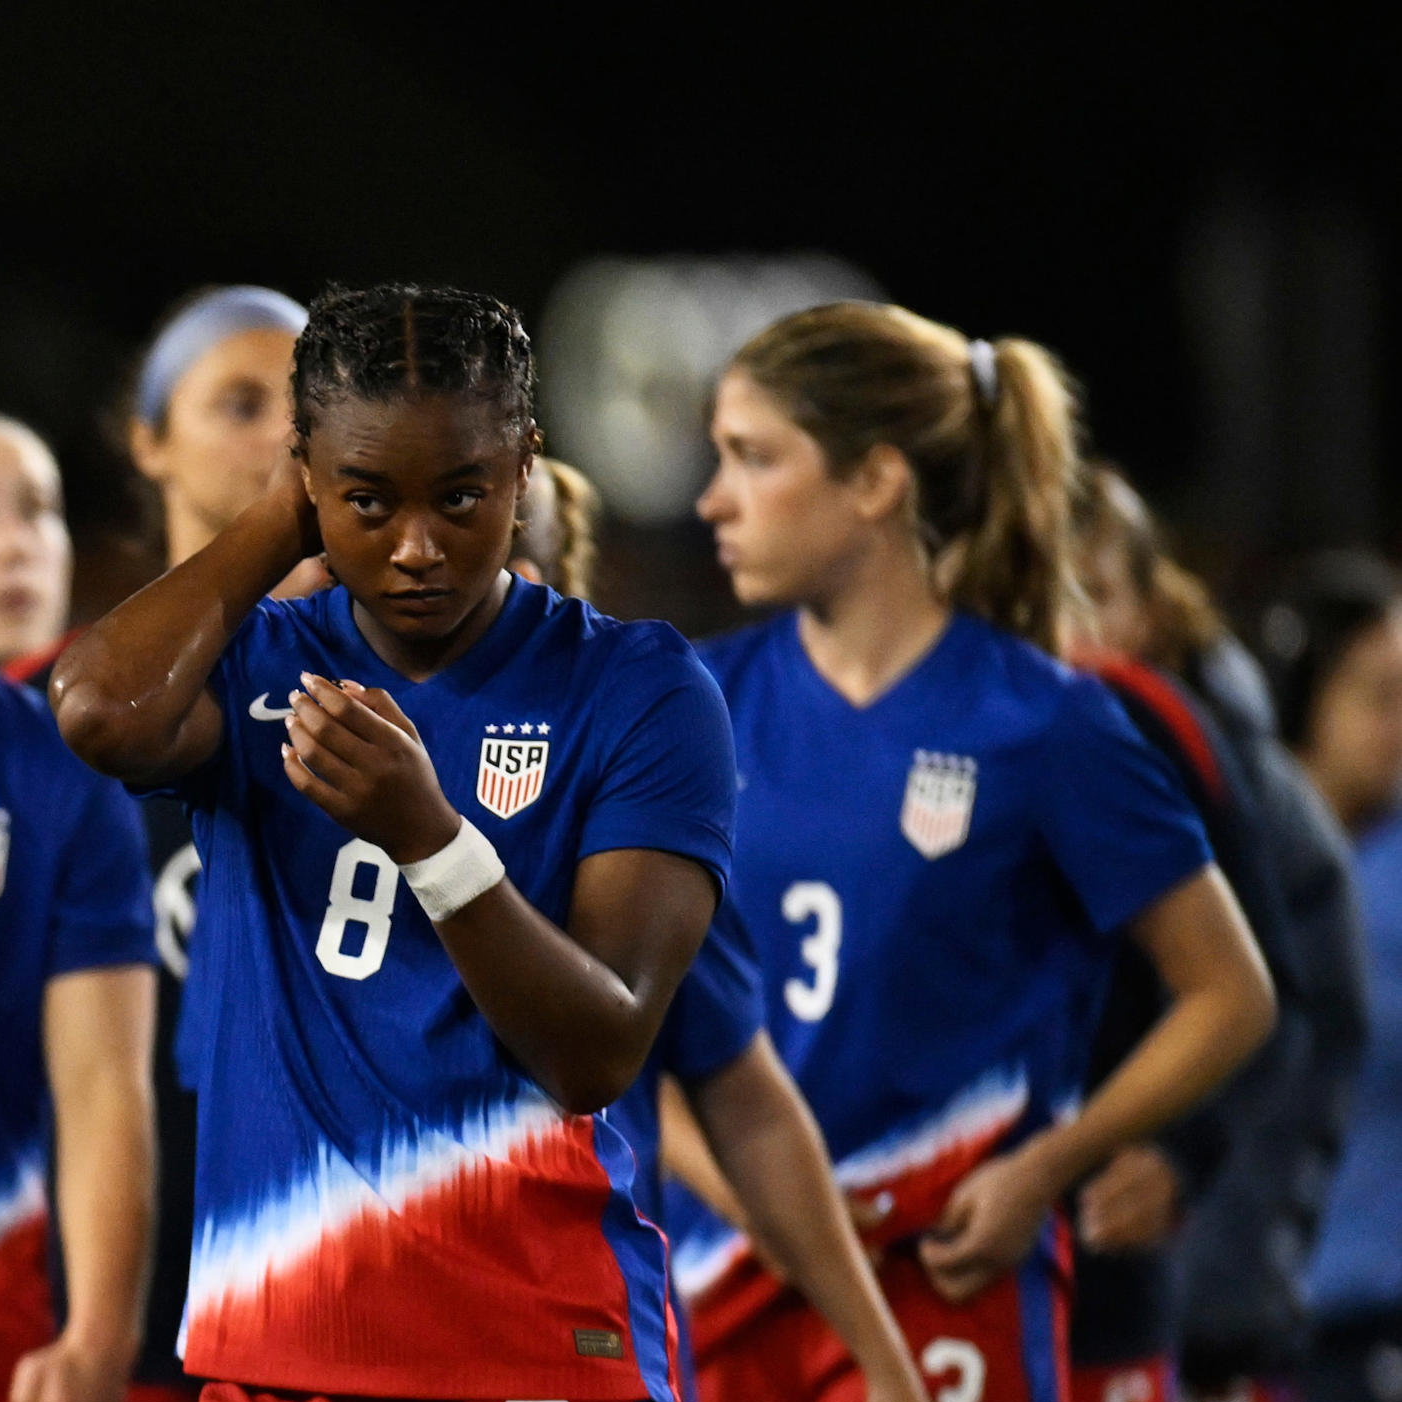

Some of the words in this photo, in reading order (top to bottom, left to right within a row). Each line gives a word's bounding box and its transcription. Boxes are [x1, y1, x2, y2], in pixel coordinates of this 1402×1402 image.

[485, 744, 543, 774] USA
[315, 838, 399, 981] 8
[782, 880, 842, 1023] 3
